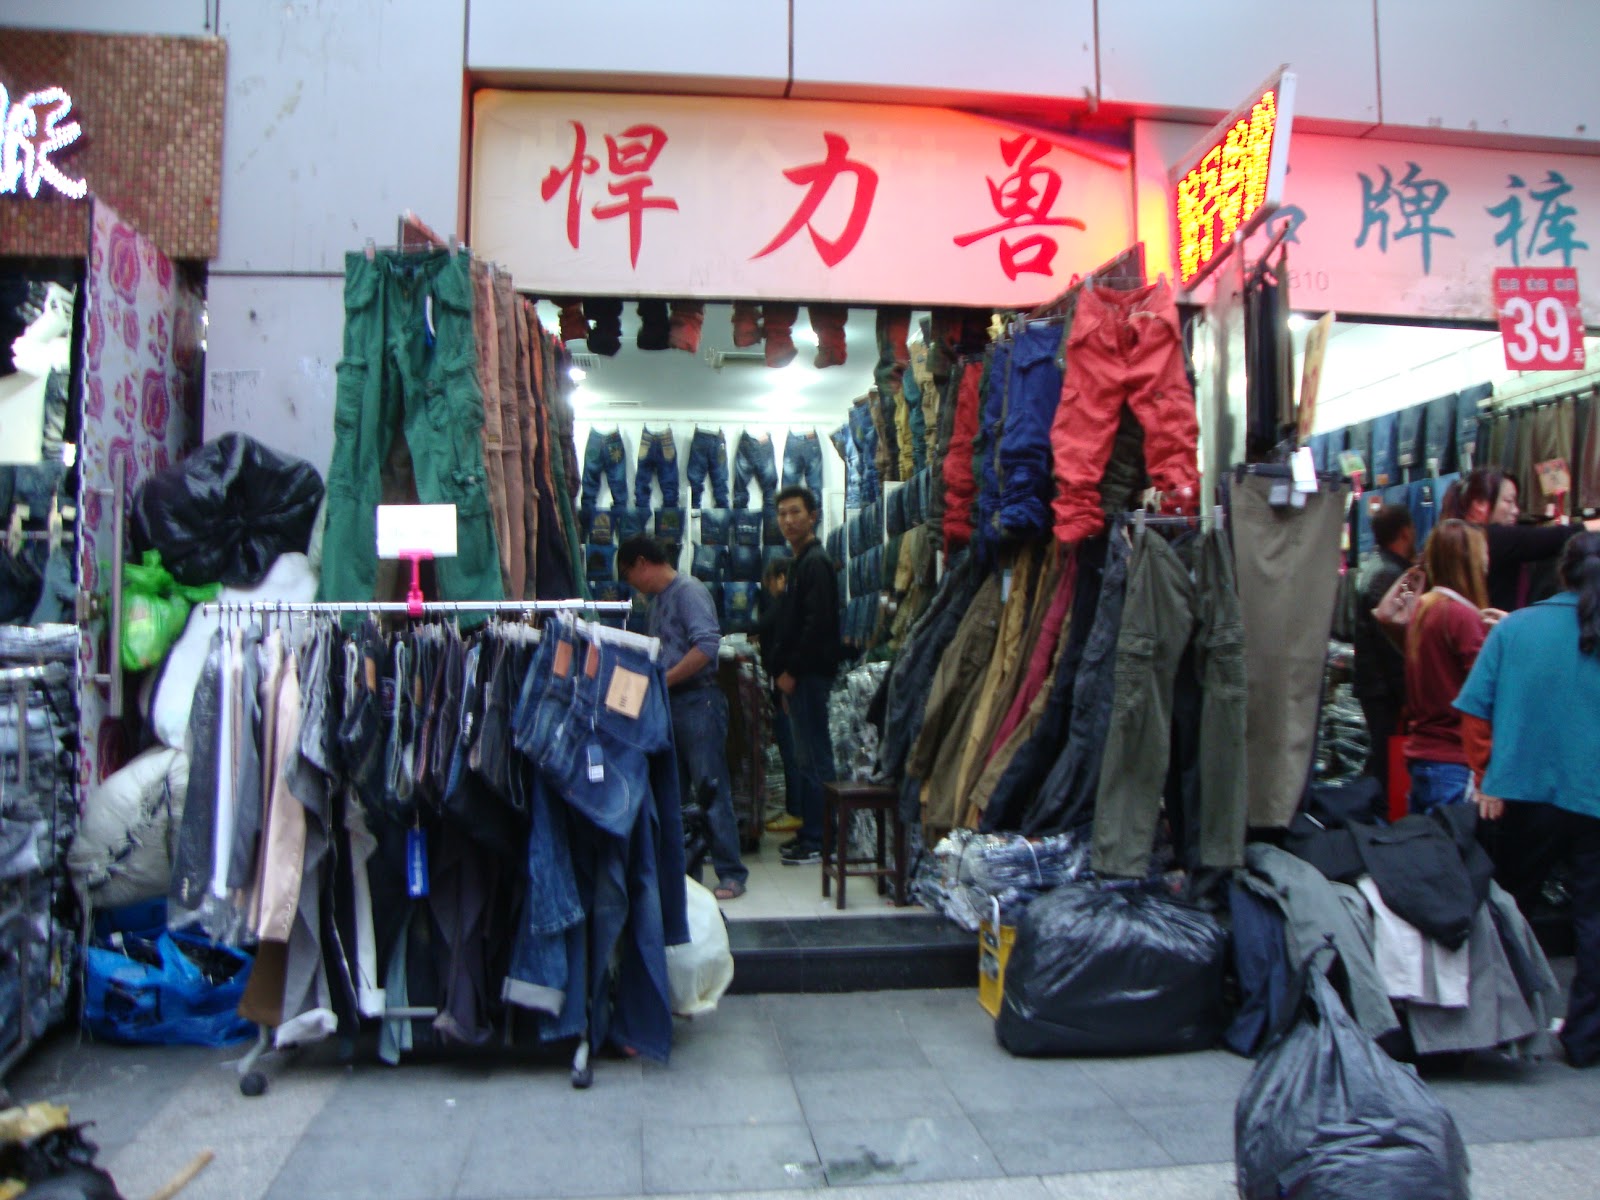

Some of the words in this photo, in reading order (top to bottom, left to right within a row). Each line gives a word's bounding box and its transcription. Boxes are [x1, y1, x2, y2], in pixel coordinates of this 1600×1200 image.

[541, 119, 1086, 281] 悍力兽
[1500, 296, 1571, 363] 39
